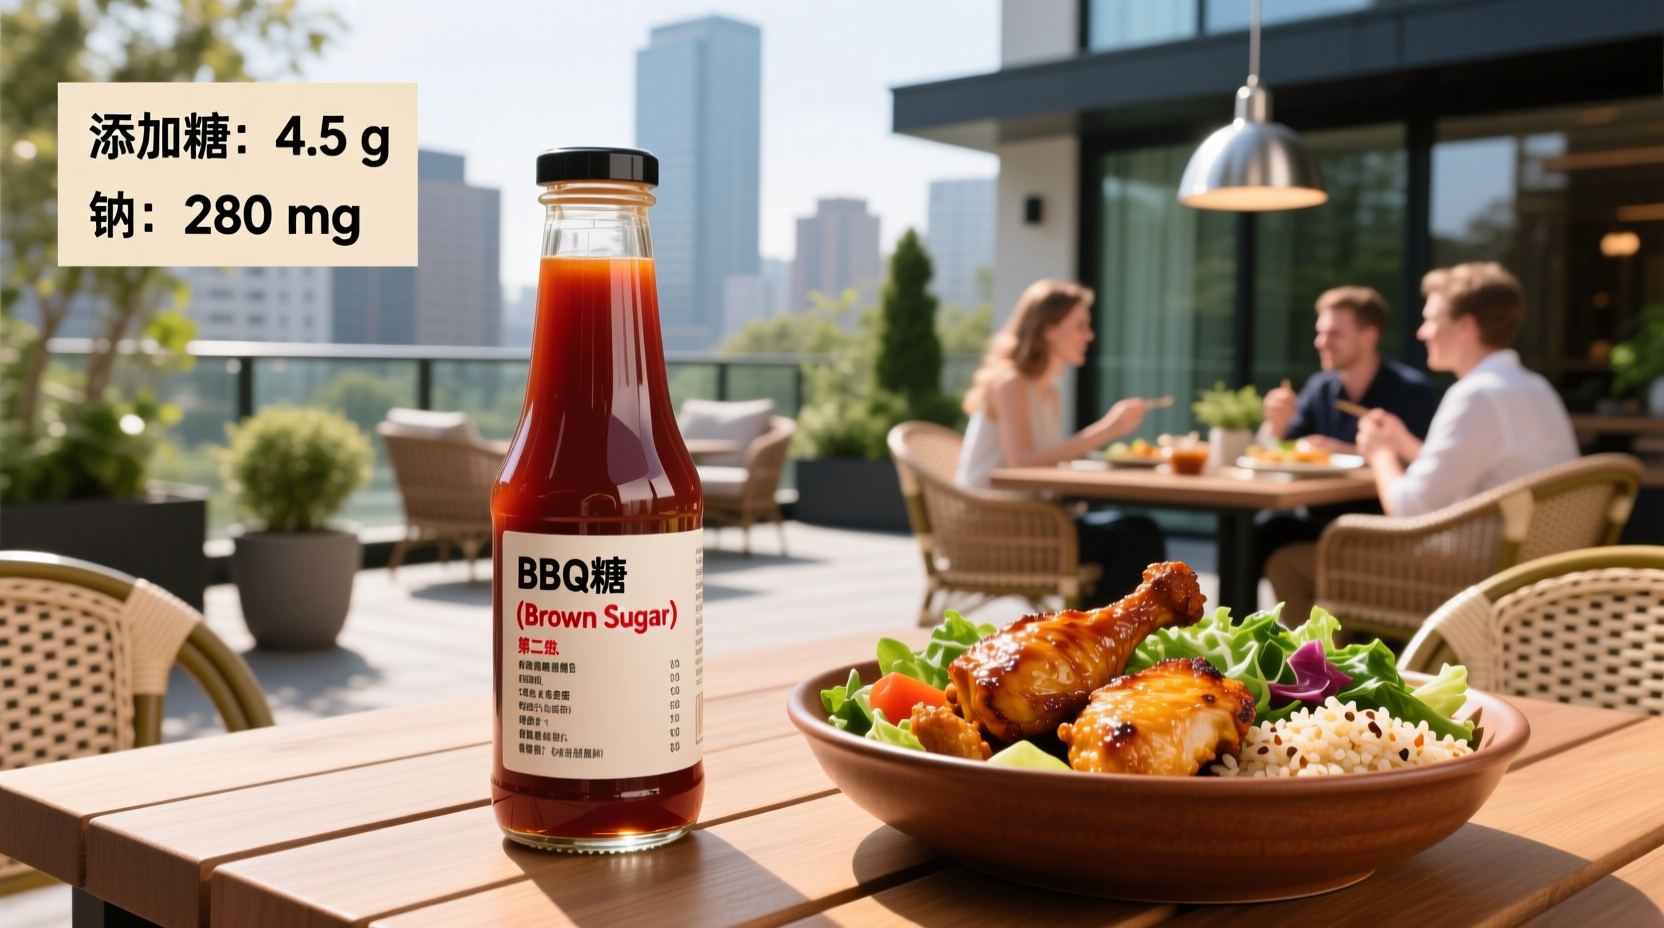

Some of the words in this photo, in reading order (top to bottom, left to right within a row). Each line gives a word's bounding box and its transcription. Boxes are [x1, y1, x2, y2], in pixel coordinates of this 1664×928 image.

[517, 556, 628, 595] BBQ糖
[516, 600, 597, 630] (Brown
[604, 600, 678, 634] Sugar)
